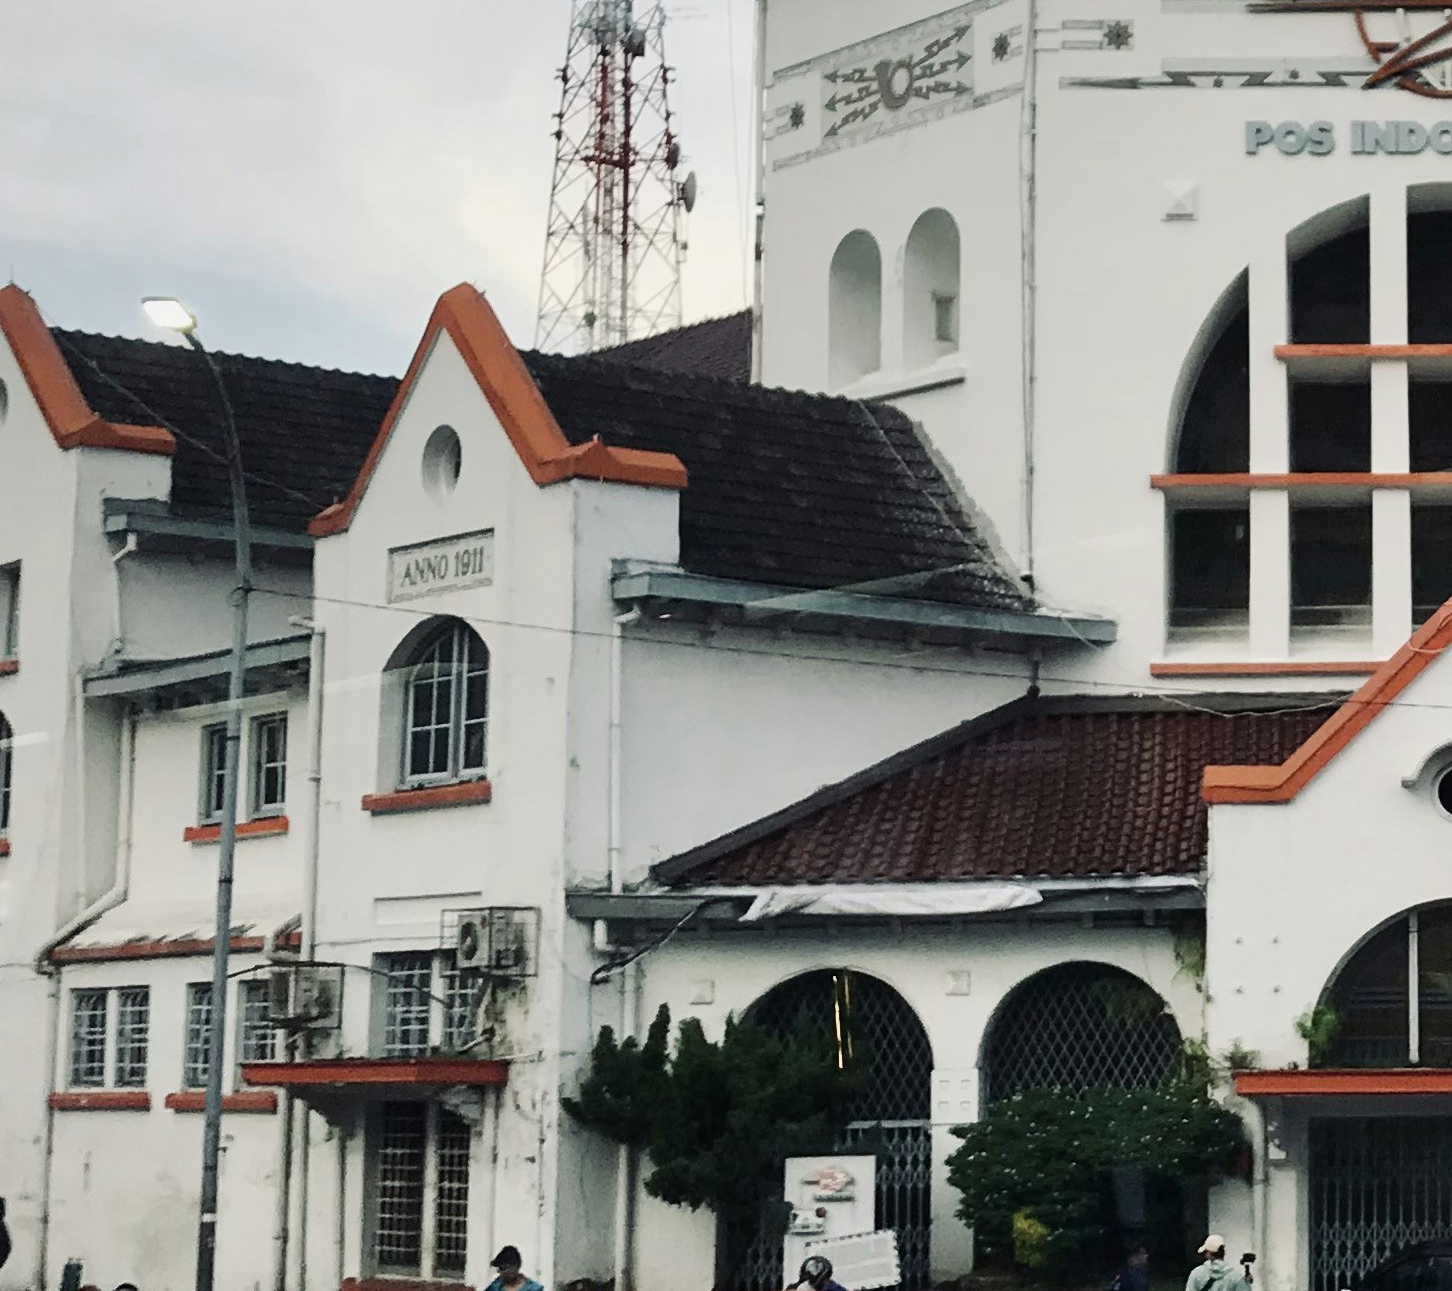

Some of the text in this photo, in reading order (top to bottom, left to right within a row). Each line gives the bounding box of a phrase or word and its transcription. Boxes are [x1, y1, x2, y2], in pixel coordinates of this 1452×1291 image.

[1245, 119, 1335, 156] POS
[400, 545, 484, 587] ANNO 1911
